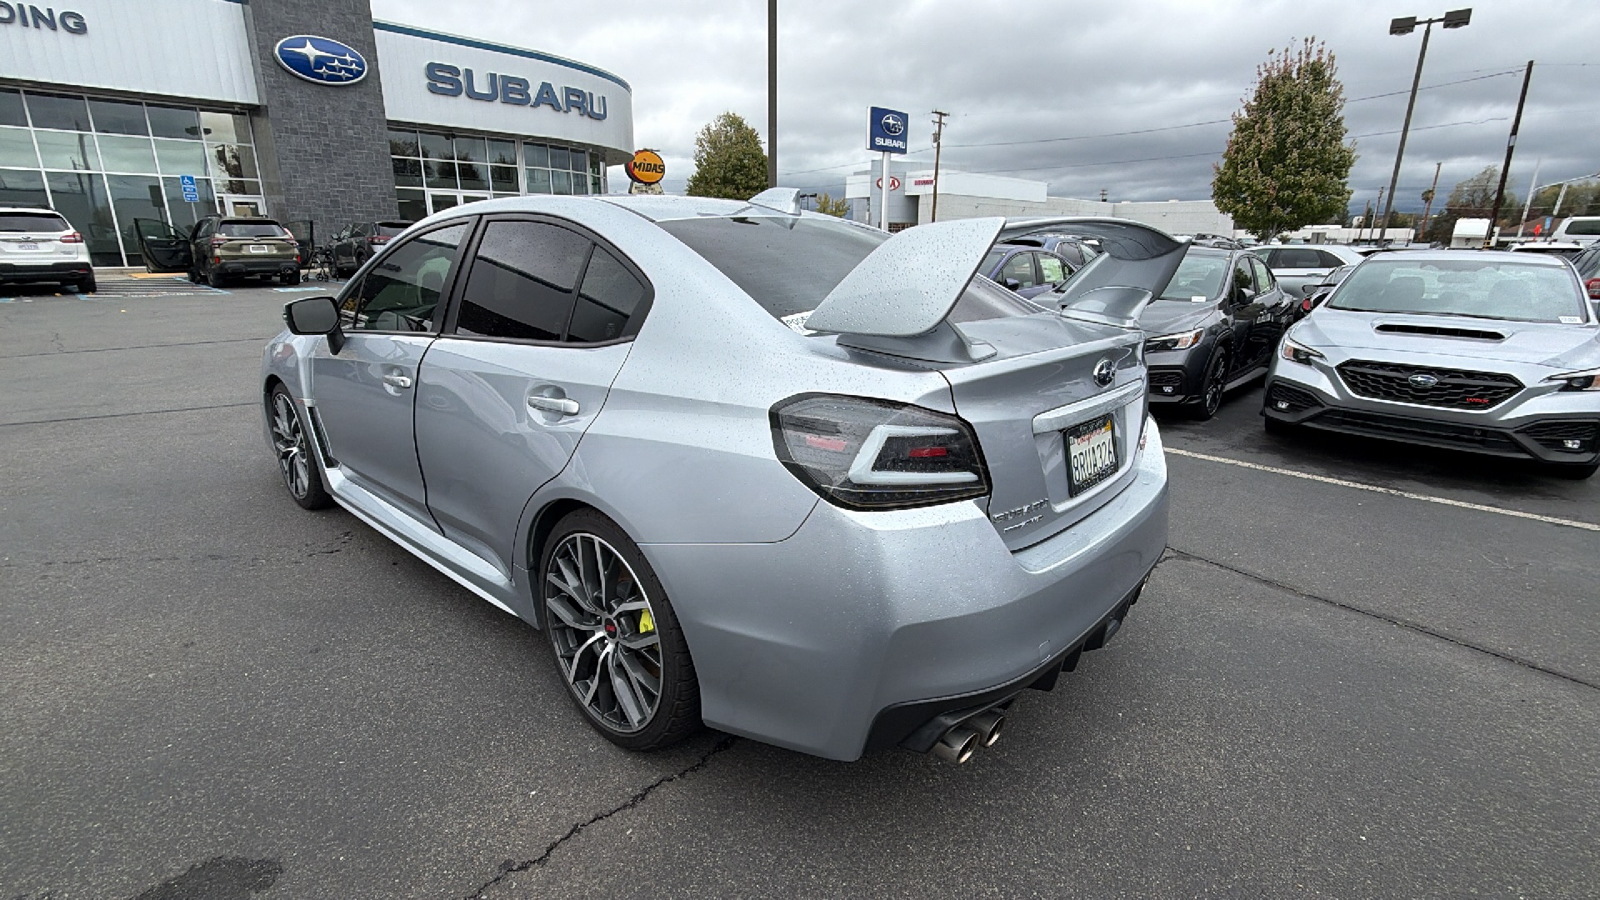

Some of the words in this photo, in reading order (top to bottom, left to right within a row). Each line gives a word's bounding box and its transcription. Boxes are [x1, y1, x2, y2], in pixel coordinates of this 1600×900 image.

[426, 61, 608, 121] SUBARU
[875, 137, 906, 149] SUBARU
[632, 160, 665, 174] MIDAS
